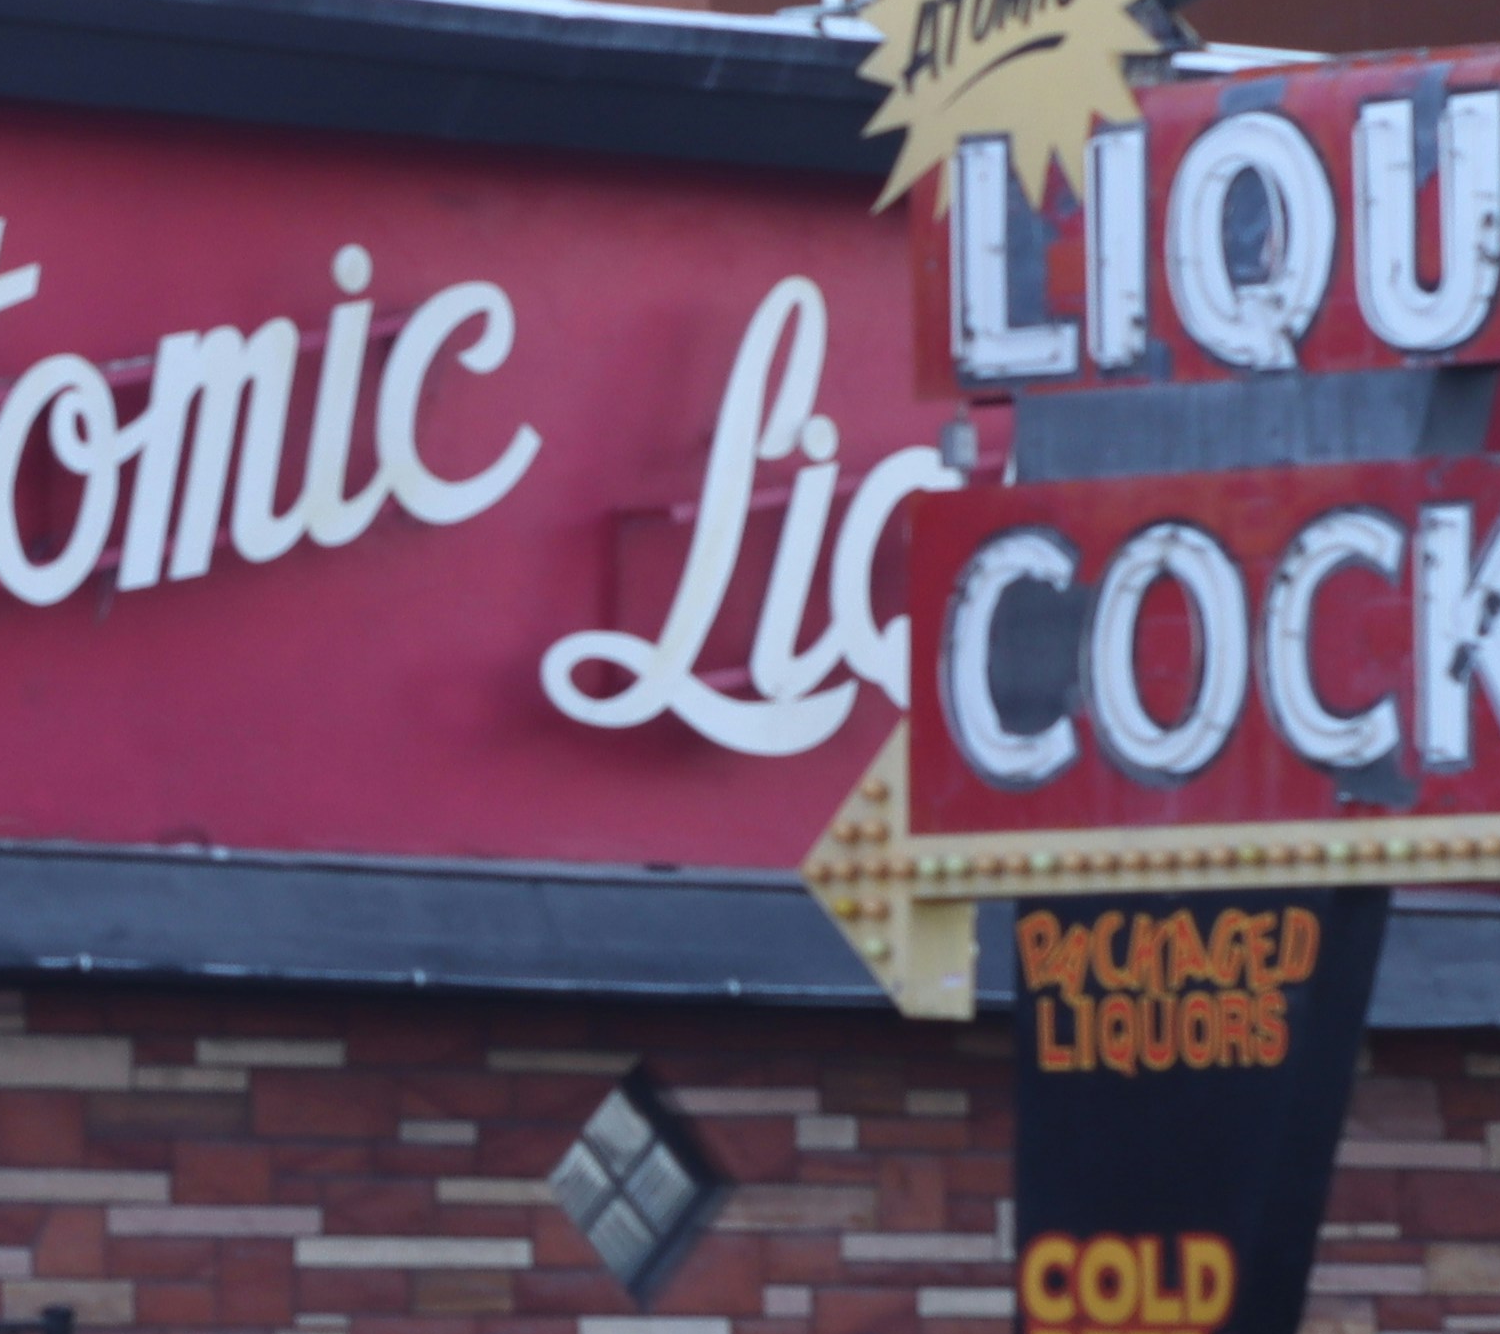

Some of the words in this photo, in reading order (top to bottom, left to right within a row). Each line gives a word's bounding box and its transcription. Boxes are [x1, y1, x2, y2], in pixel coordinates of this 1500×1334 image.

[1015, 906, 1322, 999] PACKAGED
[1036, 990, 1290, 1077] LIQUORS
[1018, 1232, 1237, 1327] COLD
